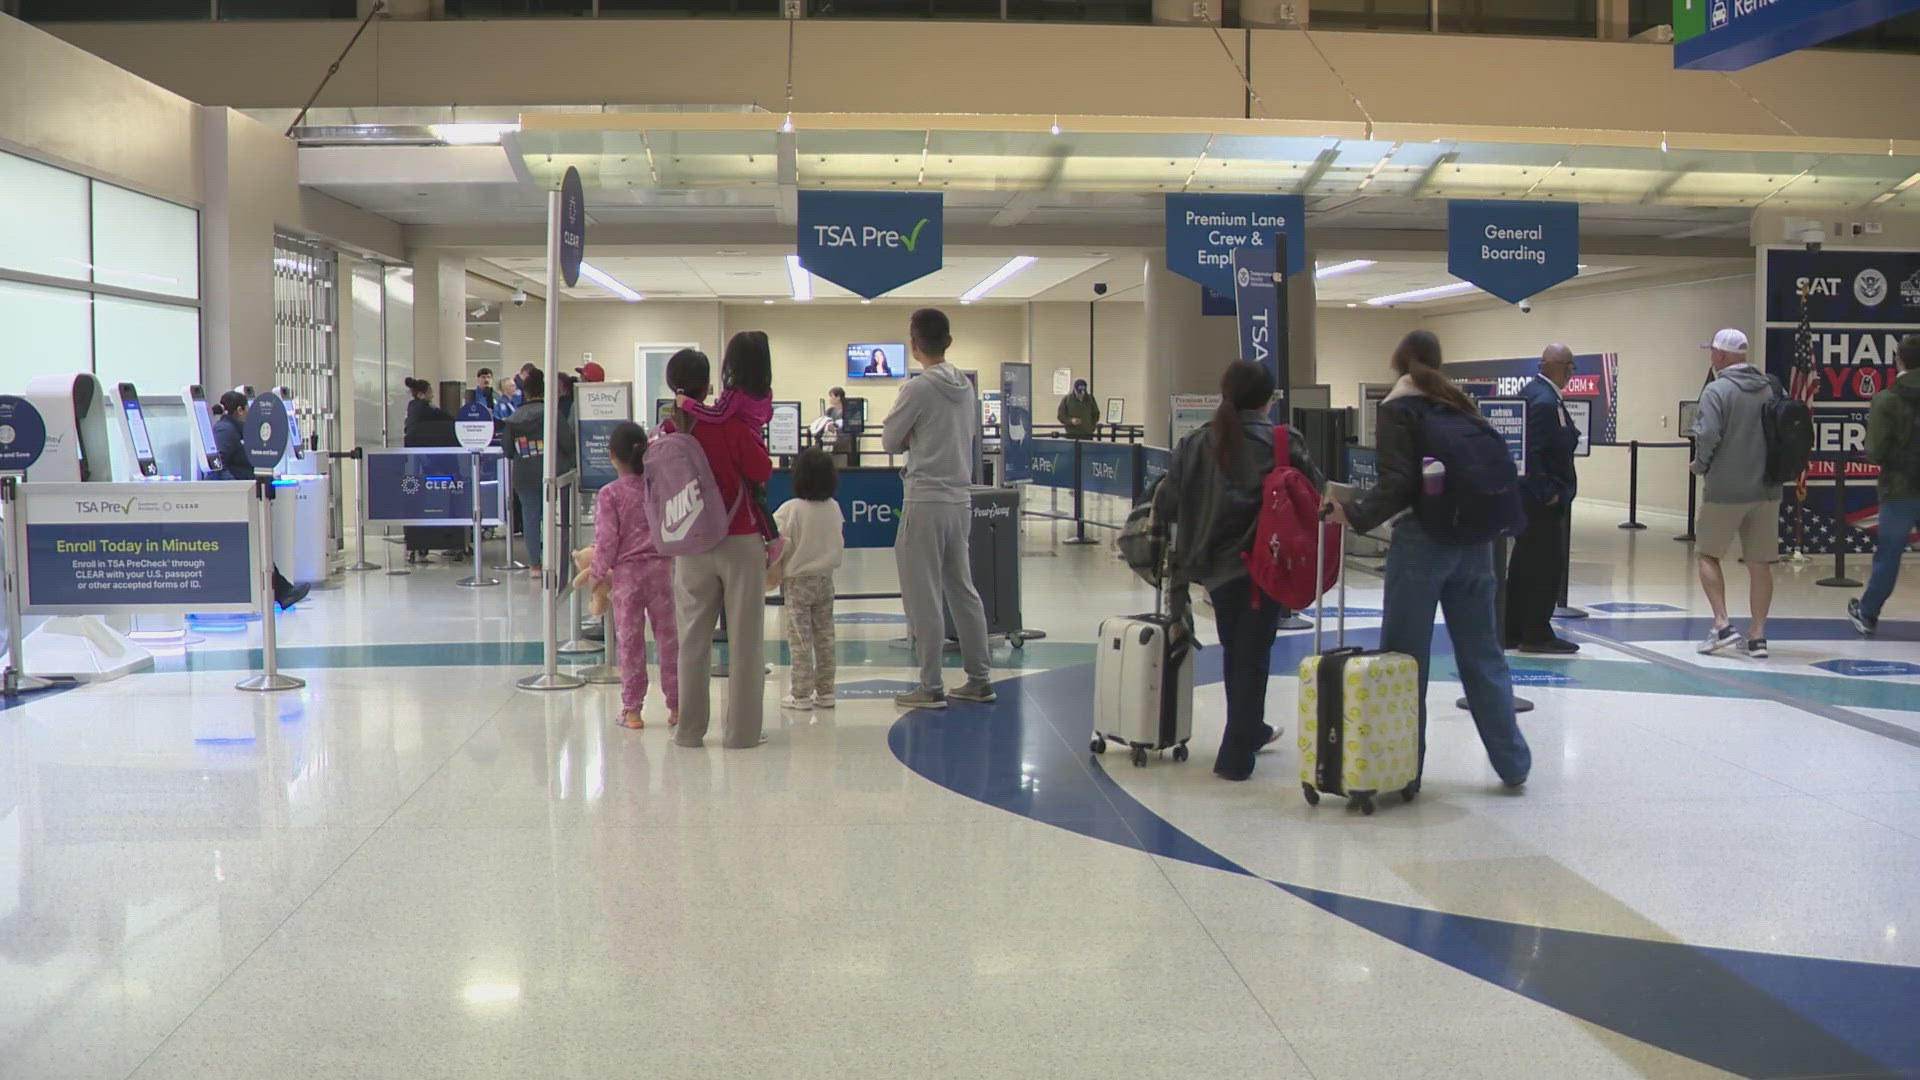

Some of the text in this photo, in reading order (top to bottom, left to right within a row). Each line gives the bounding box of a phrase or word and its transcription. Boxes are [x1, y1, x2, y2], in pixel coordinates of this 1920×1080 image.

[1186, 210, 1286, 227] Premium Lane
[813, 225, 900, 247] TSA Pre
[1208, 230, 1264, 246] Crew &
[1484, 224, 1542, 240] General
[1198, 249, 1234, 269] Empl
[1482, 244, 1546, 264] Boarding
[1796, 277, 1842, 296] SAT
[1251, 308, 1269, 362] TSA
[1795, 333, 1902, 365] HAN
[1498, 376, 1587, 396] HERO ORM
[1851, 413, 1862, 421] TO
[1812, 423, 1868, 451] ER
[1818, 460, 1835, 473] IN
[425, 480, 464, 490] CLEAR
[76, 501, 99, 513] TSA
[100, 501, 121, 513] Pre
[665, 478, 704, 528] NIKE
[852, 499, 891, 523] Pre
[56, 538, 219, 555] Enroll Today in Minutes
[72, 559, 96, 569] Enroll
[97, 559, 105, 568] in
[107, 559, 125, 568] TSA
[171, 559, 205, 570] through
[75, 570, 202, 580] CLEAR with your U.S. passport
[77, 580, 201, 592] or other accepted forms of ID.
